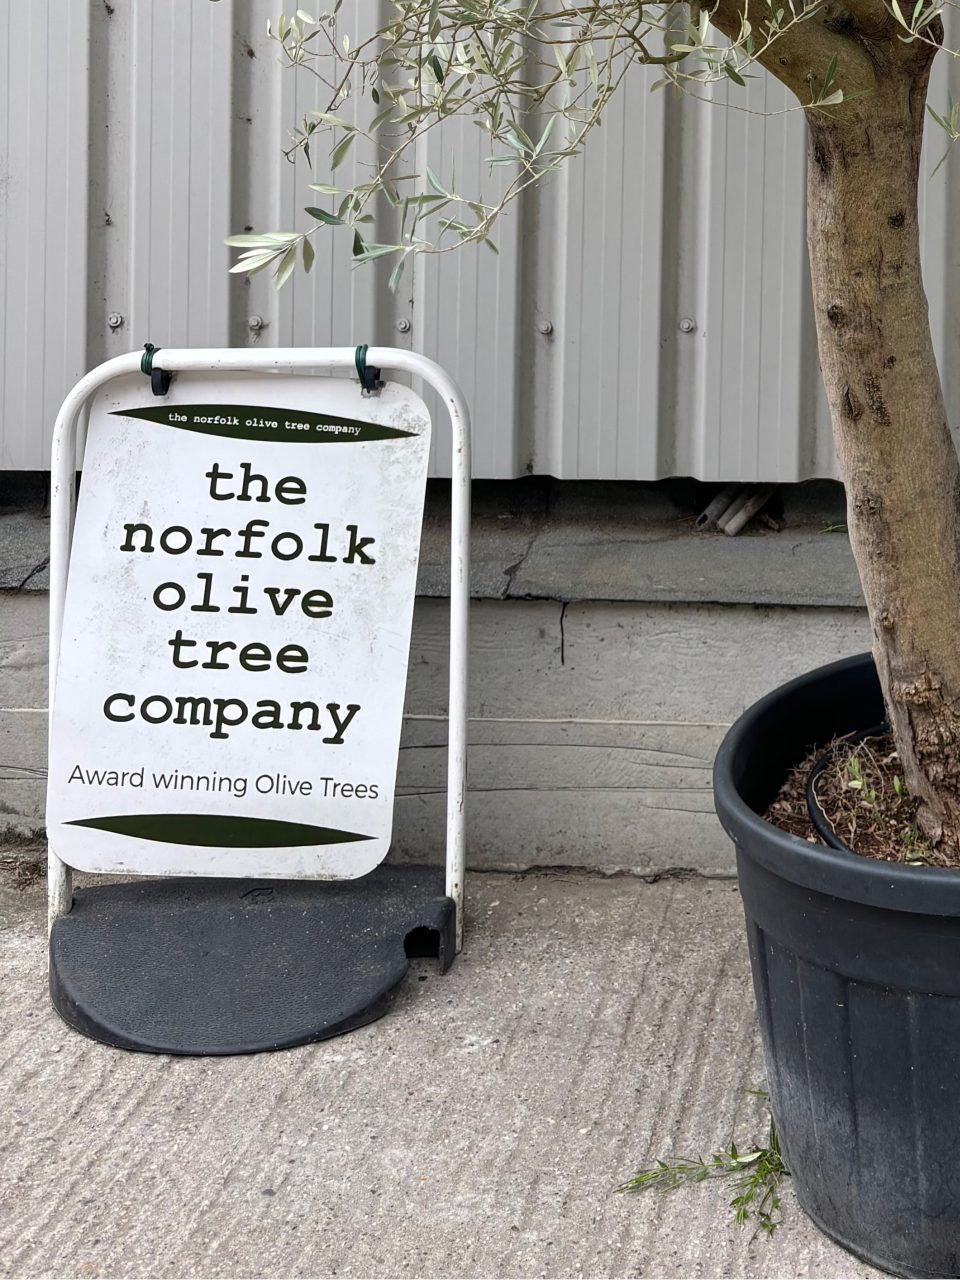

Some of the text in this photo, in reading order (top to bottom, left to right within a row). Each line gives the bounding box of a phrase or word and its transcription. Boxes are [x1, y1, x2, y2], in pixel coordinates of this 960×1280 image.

[168, 412, 361, 436] the norfolk olive tree company
[205, 462, 307, 505] the
[119, 519, 376, 565] norfolk
[152, 572, 334, 618] olive
[168, 629, 309, 674] tree
[103, 692, 361, 745] company
[67, 764, 379, 800] Award winning Olive Trees
